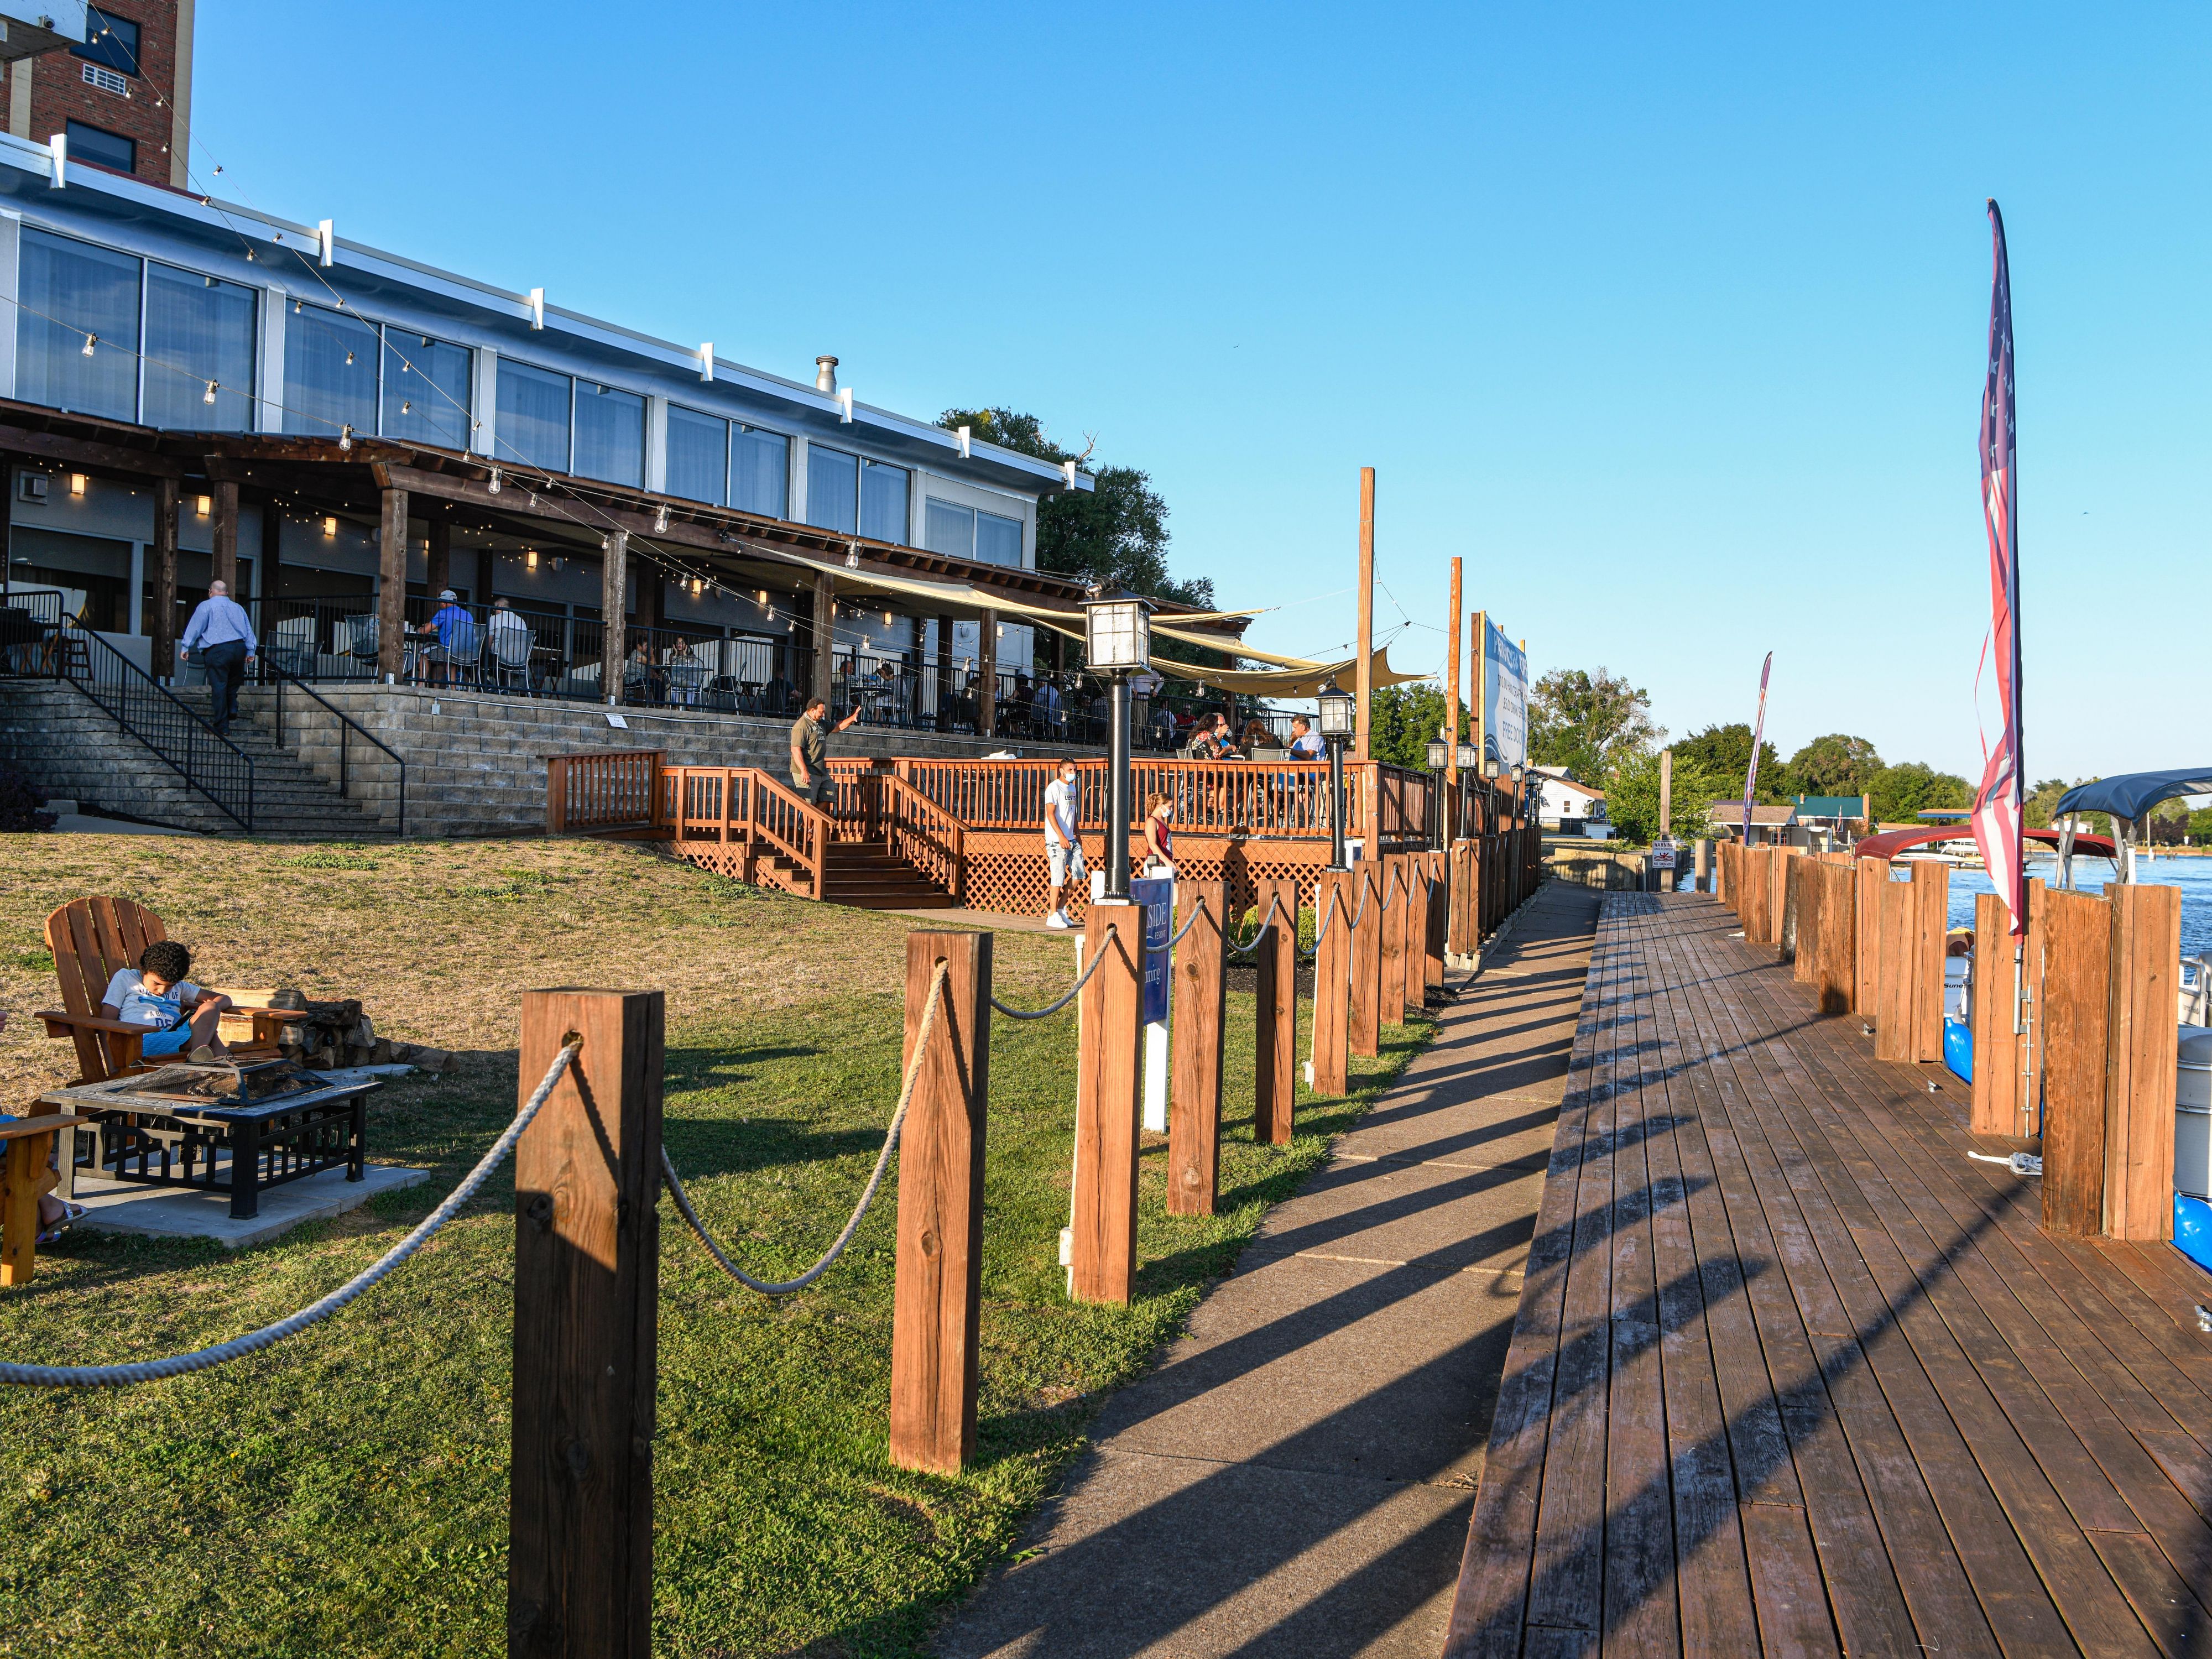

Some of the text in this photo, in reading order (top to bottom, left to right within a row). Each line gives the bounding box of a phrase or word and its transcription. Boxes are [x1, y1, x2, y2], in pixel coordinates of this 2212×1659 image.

[1503, 721, 1512, 741] FREE
[1147, 902, 1166, 928] SIDE
[1155, 930, 1166, 940] RESORT
